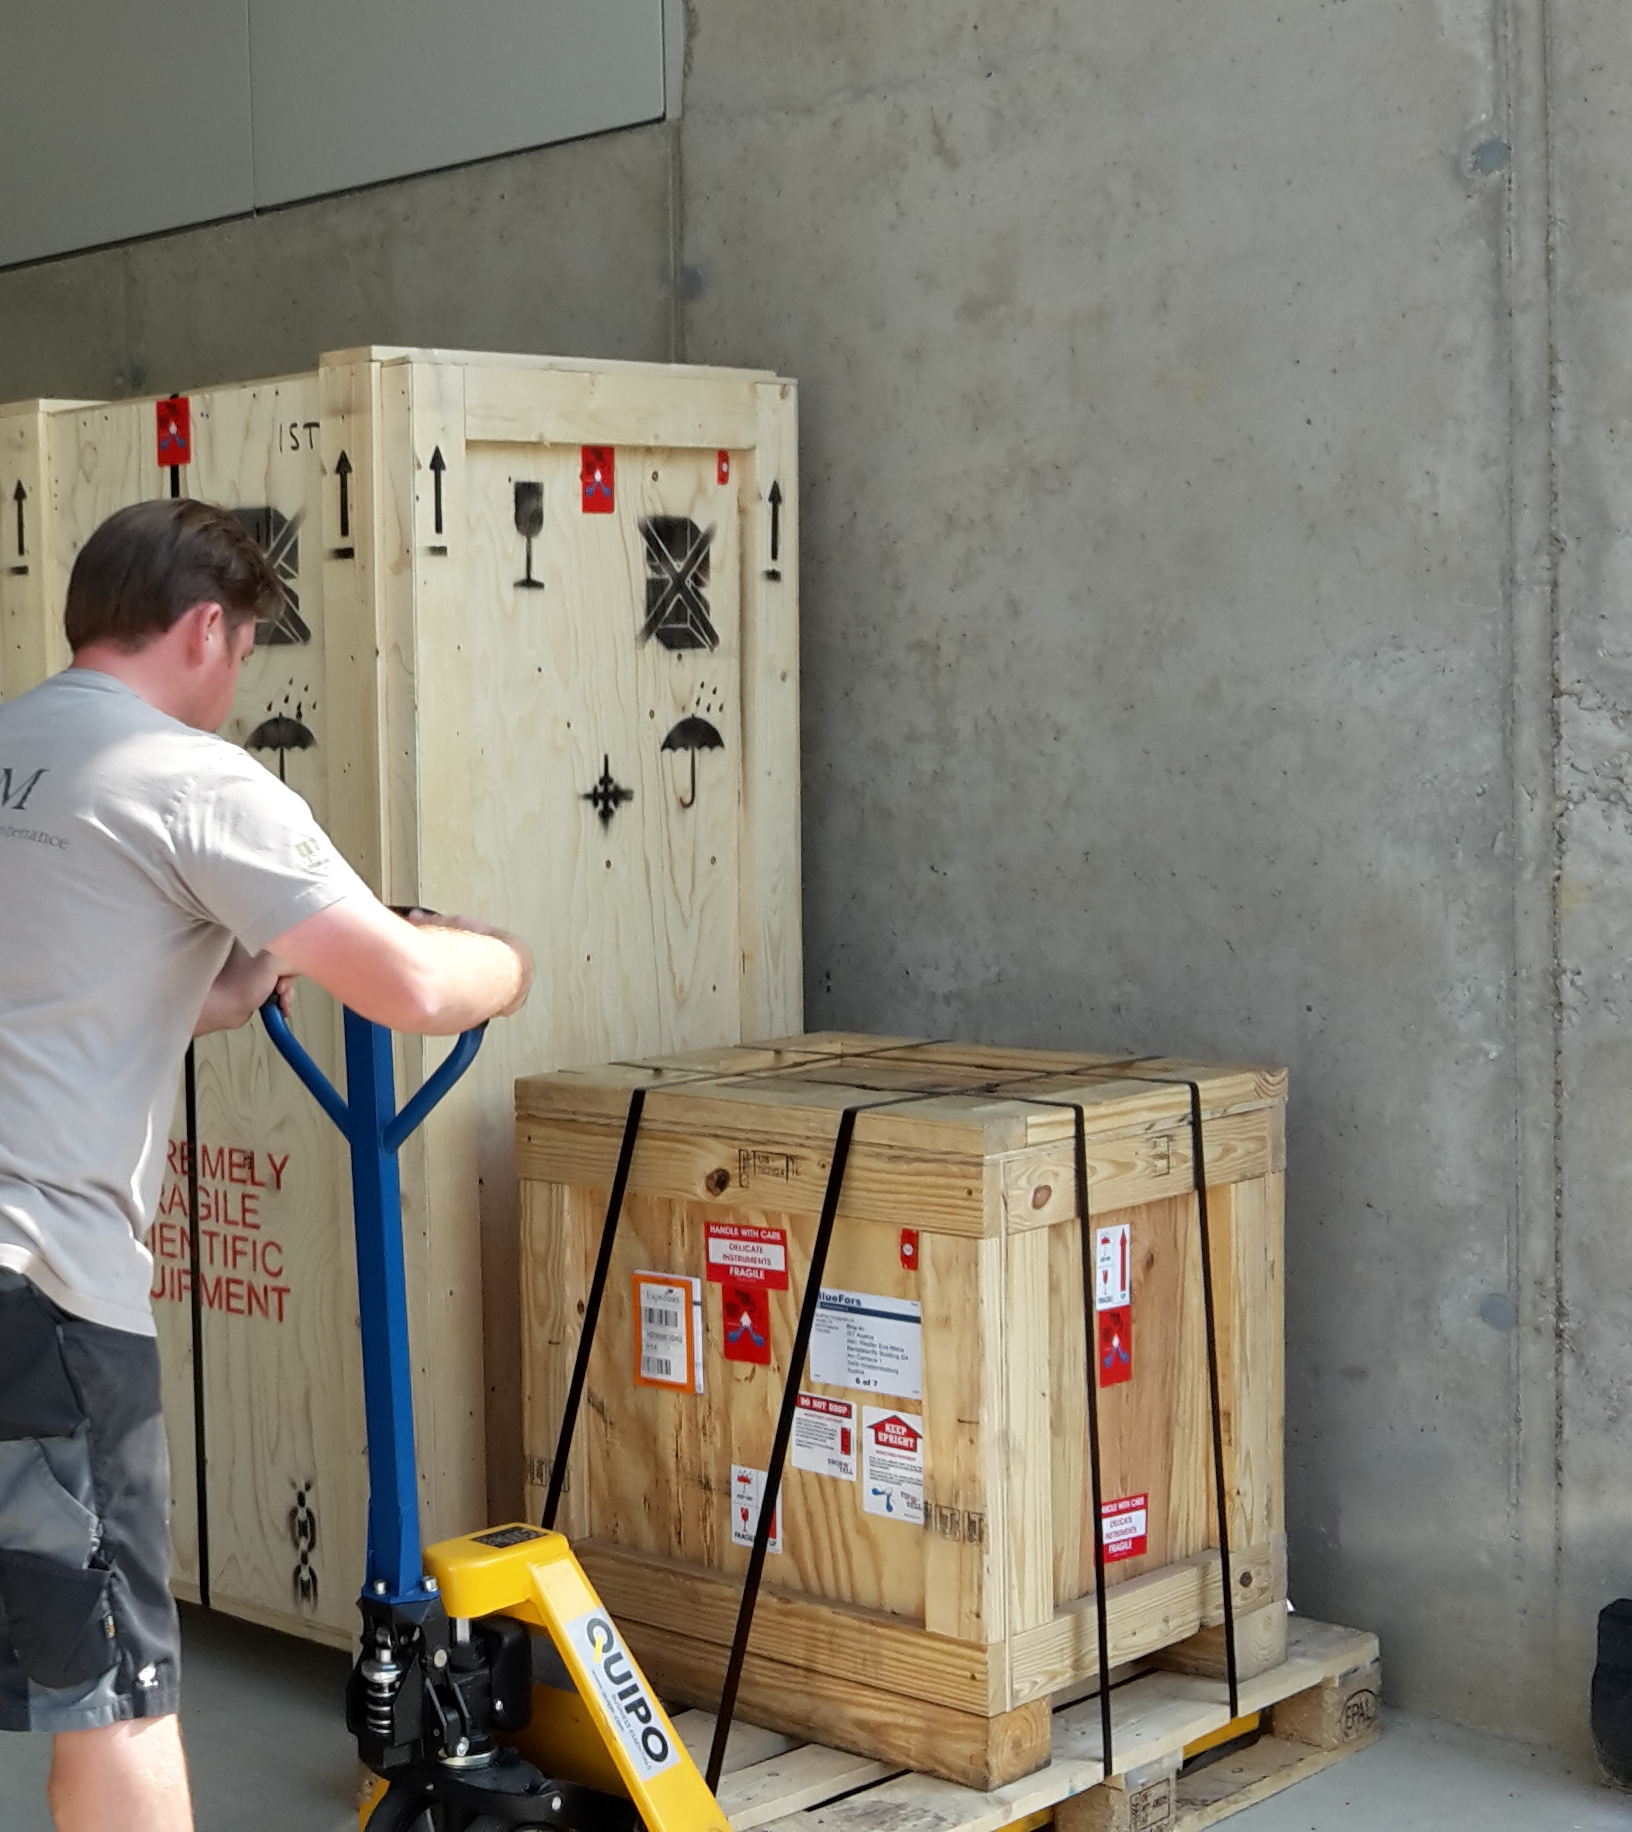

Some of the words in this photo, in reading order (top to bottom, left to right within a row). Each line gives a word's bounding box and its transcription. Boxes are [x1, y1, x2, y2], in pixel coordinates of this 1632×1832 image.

[279, 421, 320, 454] IST
[760, 1230, 782, 1241] CARE
[144, 1221, 285, 1279] IENTIFIC
[729, 1243, 764, 1254] DELICATE
[729, 1266, 765, 1280] FRAGILE
[817, 1291, 862, 1307] lueFors
[884, 1423, 908, 1436] KEEP
[878, 1432, 915, 1448] UPRIGHT
[586, 1617, 669, 1764] QUIPO
